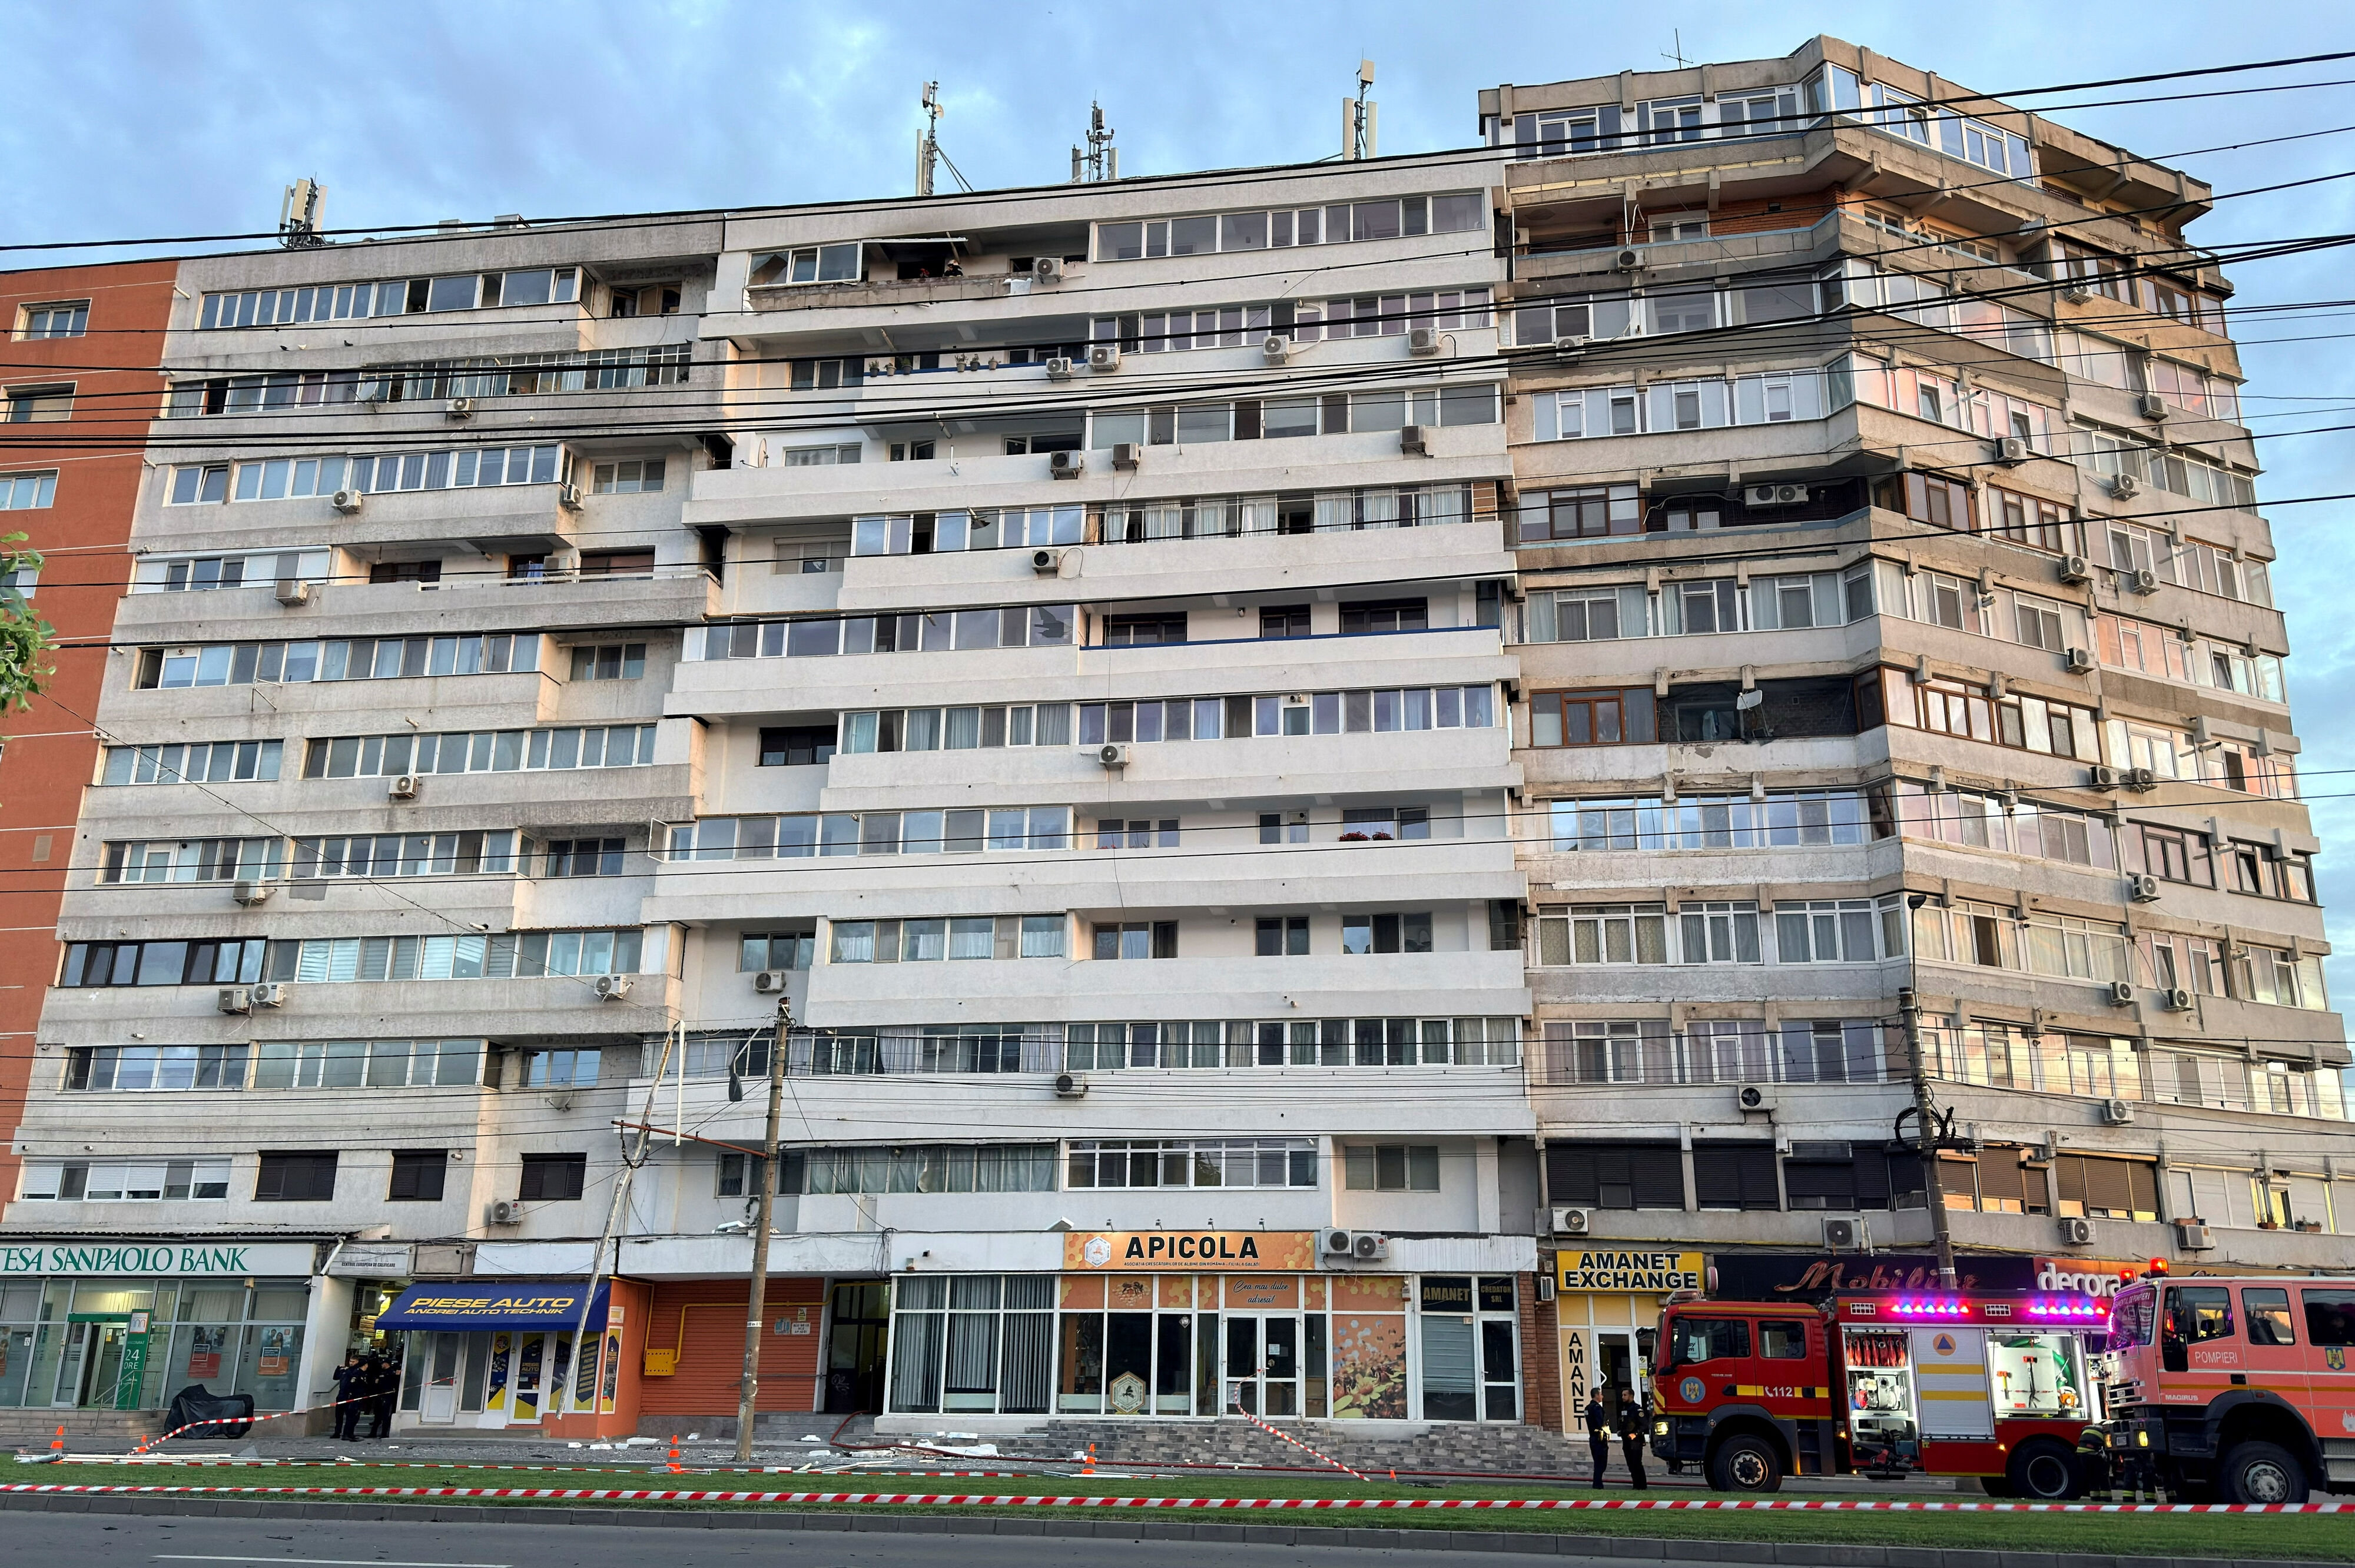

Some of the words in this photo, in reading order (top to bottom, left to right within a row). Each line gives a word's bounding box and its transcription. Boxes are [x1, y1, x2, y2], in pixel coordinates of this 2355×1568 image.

[1125, 1236, 1259, 1258] APICOLA
[49, 1247, 173, 1271] SANPAOLO
[178, 1247, 250, 1272] BANK
[1579, 1253, 1680, 1270] AMANET
[1233, 1280, 1252, 1293] Cea
[1271, 1281, 1289, 1290] dulce
[1565, 1271, 1698, 1289] EXCHANGE
[1248, 1294, 1275, 1303] adresă!
[1423, 1287, 1470, 1301] AMANET
[410, 1298, 492, 1308] PIESE
[490, 1298, 575, 1307] AUTO
[125, 1349, 140, 1361] 24
[2195, 1351, 2238, 1363] POMPIERI
[124, 1361, 138, 1370] ORE
[1568, 1332, 1585, 1430] AMANET
[1773, 1386, 1793, 1397] 112
